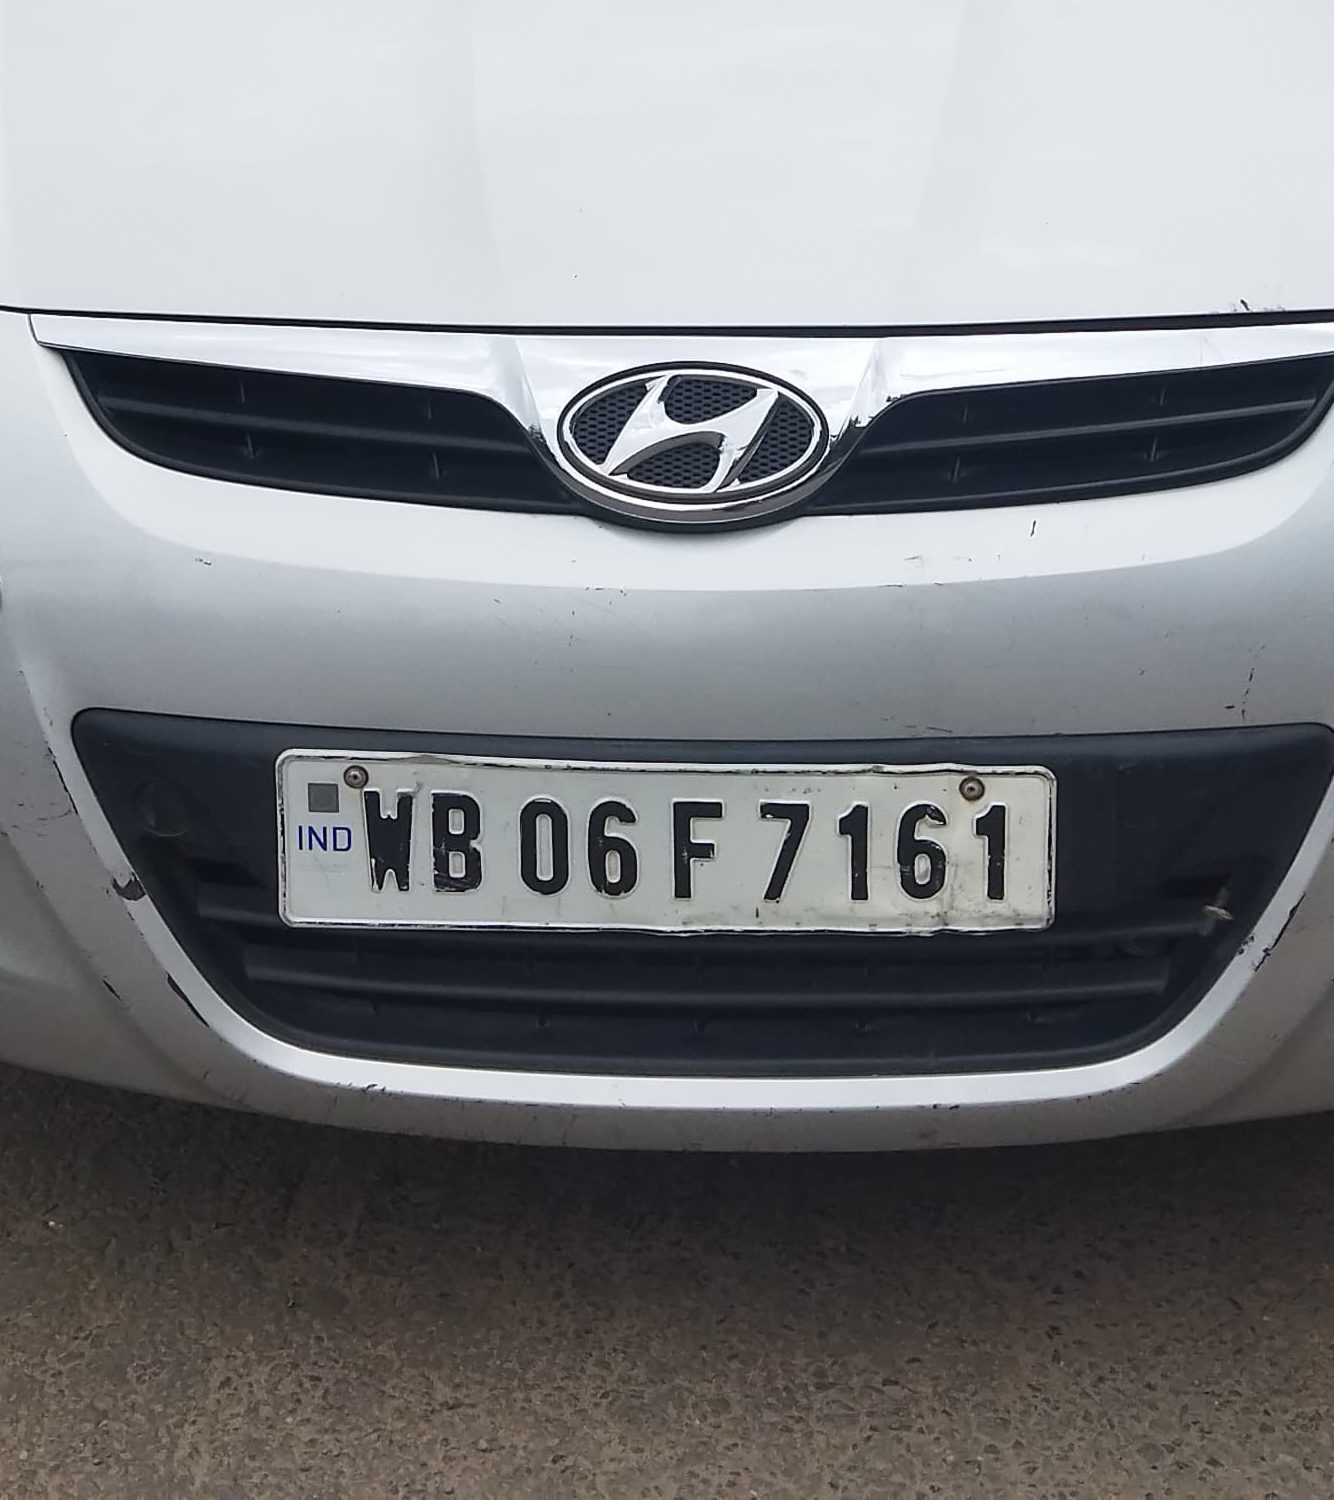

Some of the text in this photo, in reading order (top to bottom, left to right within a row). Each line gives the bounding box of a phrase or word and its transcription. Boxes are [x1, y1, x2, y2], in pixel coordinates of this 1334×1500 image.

[298, 825, 352, 852] IND
[362, 789, 1009, 902] WB 06 F 7161
